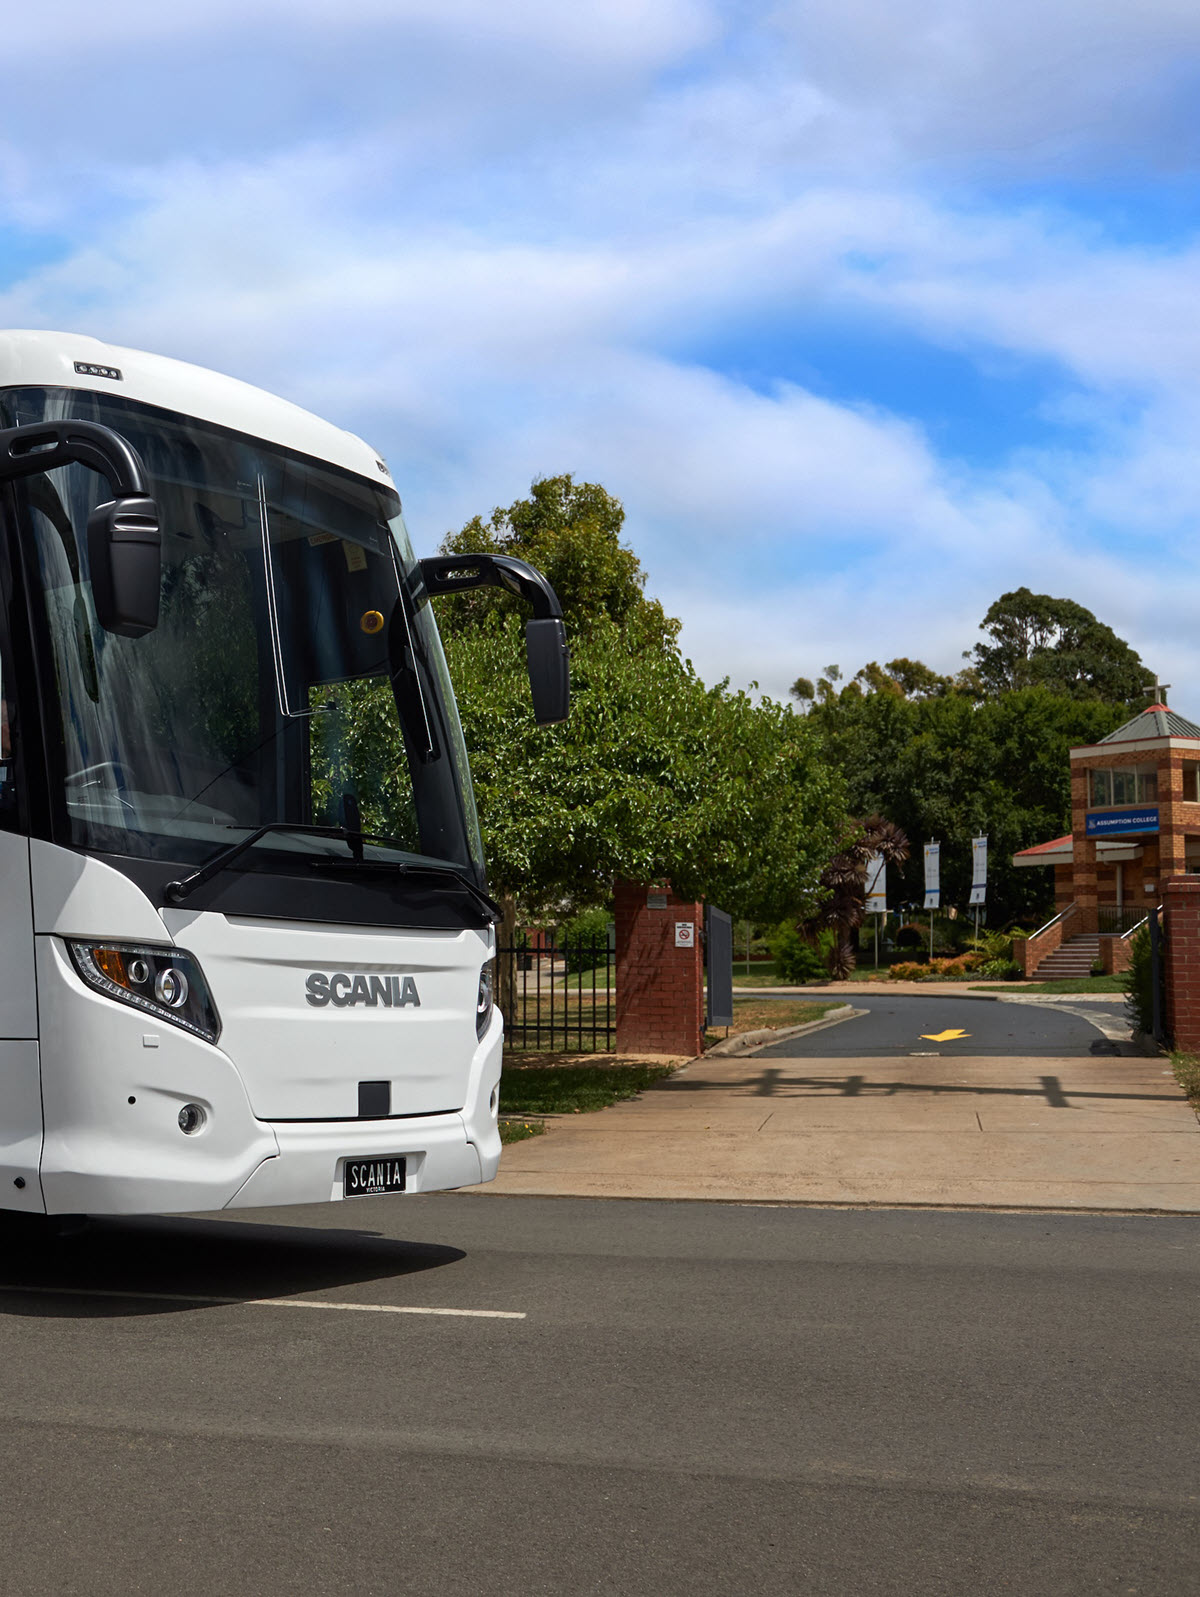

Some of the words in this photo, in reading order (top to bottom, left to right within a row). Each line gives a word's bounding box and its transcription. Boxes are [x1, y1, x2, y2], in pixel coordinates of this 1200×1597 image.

[1096, 818, 1132, 826] ASSUMPTION
[1132, 816, 1157, 824] COLLEGE
[305, 972, 421, 1008] SCANIA
[351, 1161, 401, 1188] SCANIA
